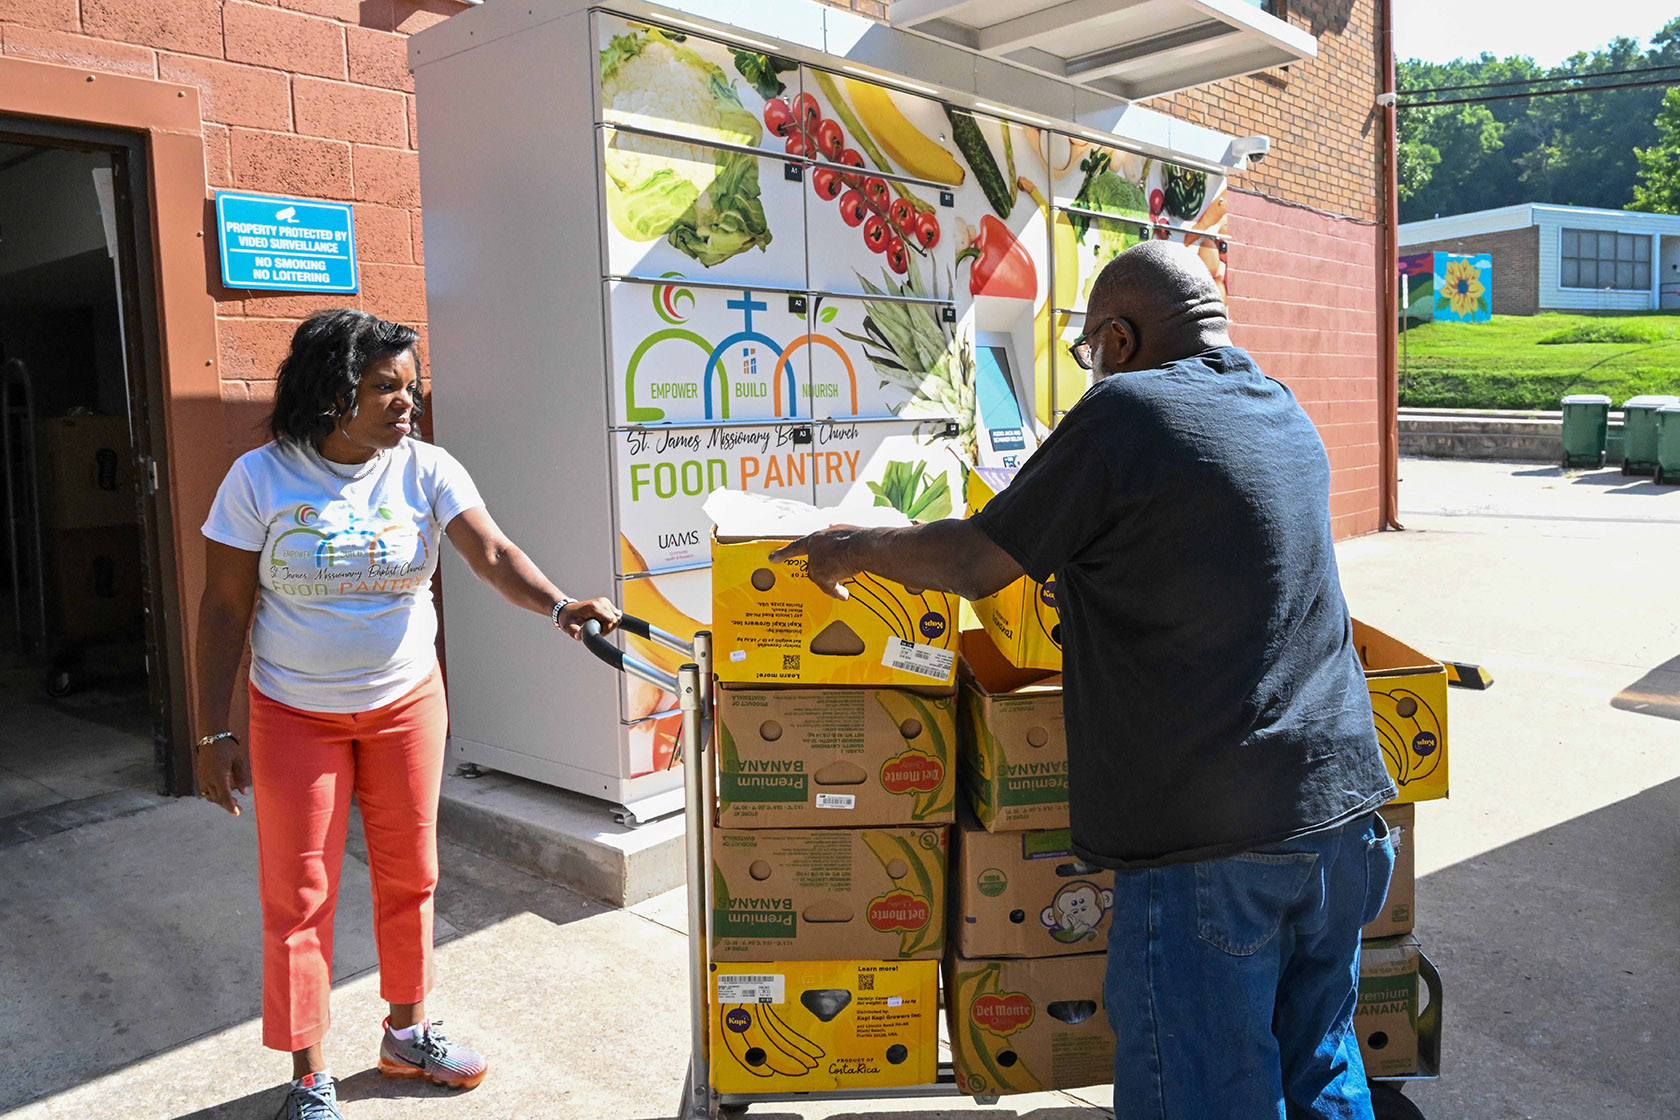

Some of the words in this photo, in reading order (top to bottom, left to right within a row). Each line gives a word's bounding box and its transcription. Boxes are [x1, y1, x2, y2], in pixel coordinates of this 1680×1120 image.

[226, 221, 277, 236] PROPERTY
[279, 226, 333, 241] PROTECTED
[334, 231, 347, 242] BY
[238, 235, 269, 248] VIDEO
[270, 238, 339, 253] SURVEILLANCE
[255, 256, 272, 268] NO
[274, 258, 326, 271] SMOKING
[253, 268, 270, 280] NO
[272, 270, 330, 283] LOITERING
[650, 382, 698, 399] EMPOWER
[735, 382, 767, 398] BUILD
[802, 383, 839, 398] NOURISH
[627, 430, 654, 456] St.
[656, 429, 701, 454] James
[707, 427, 770, 454] Missionary
[819, 424, 860, 446] Church
[630, 458, 728, 502] FOOD
[740, 450, 861, 491] PANTRY
[658, 530, 699, 549] UAMS
[282, 567, 307, 580] James
[314, 568, 362, 581] Missionary
[368, 564, 397, 580] Baptist
[399, 560, 426, 575] Church
[784, 559, 809, 573] Rica
[272, 580, 329, 596] FOOD
[339, 575, 426, 594] PANTRY
[924, 620, 943, 630] Kapi
[779, 672, 800, 680] Learn
[884, 770, 920, 783] Monte
[922, 769, 940, 781] Del
[737, 776, 804, 789] Premium
[1008, 778, 1069, 791] Premium
[728, 913, 793, 925] Premium
[871, 909, 906, 921] Monte
[909, 909, 925, 920] Del
[1358, 988, 1409, 1001] remium
[975, 1005, 993, 1017] Del
[995, 1005, 1031, 1017] Monte
[728, 1016, 747, 1026] Kapi
